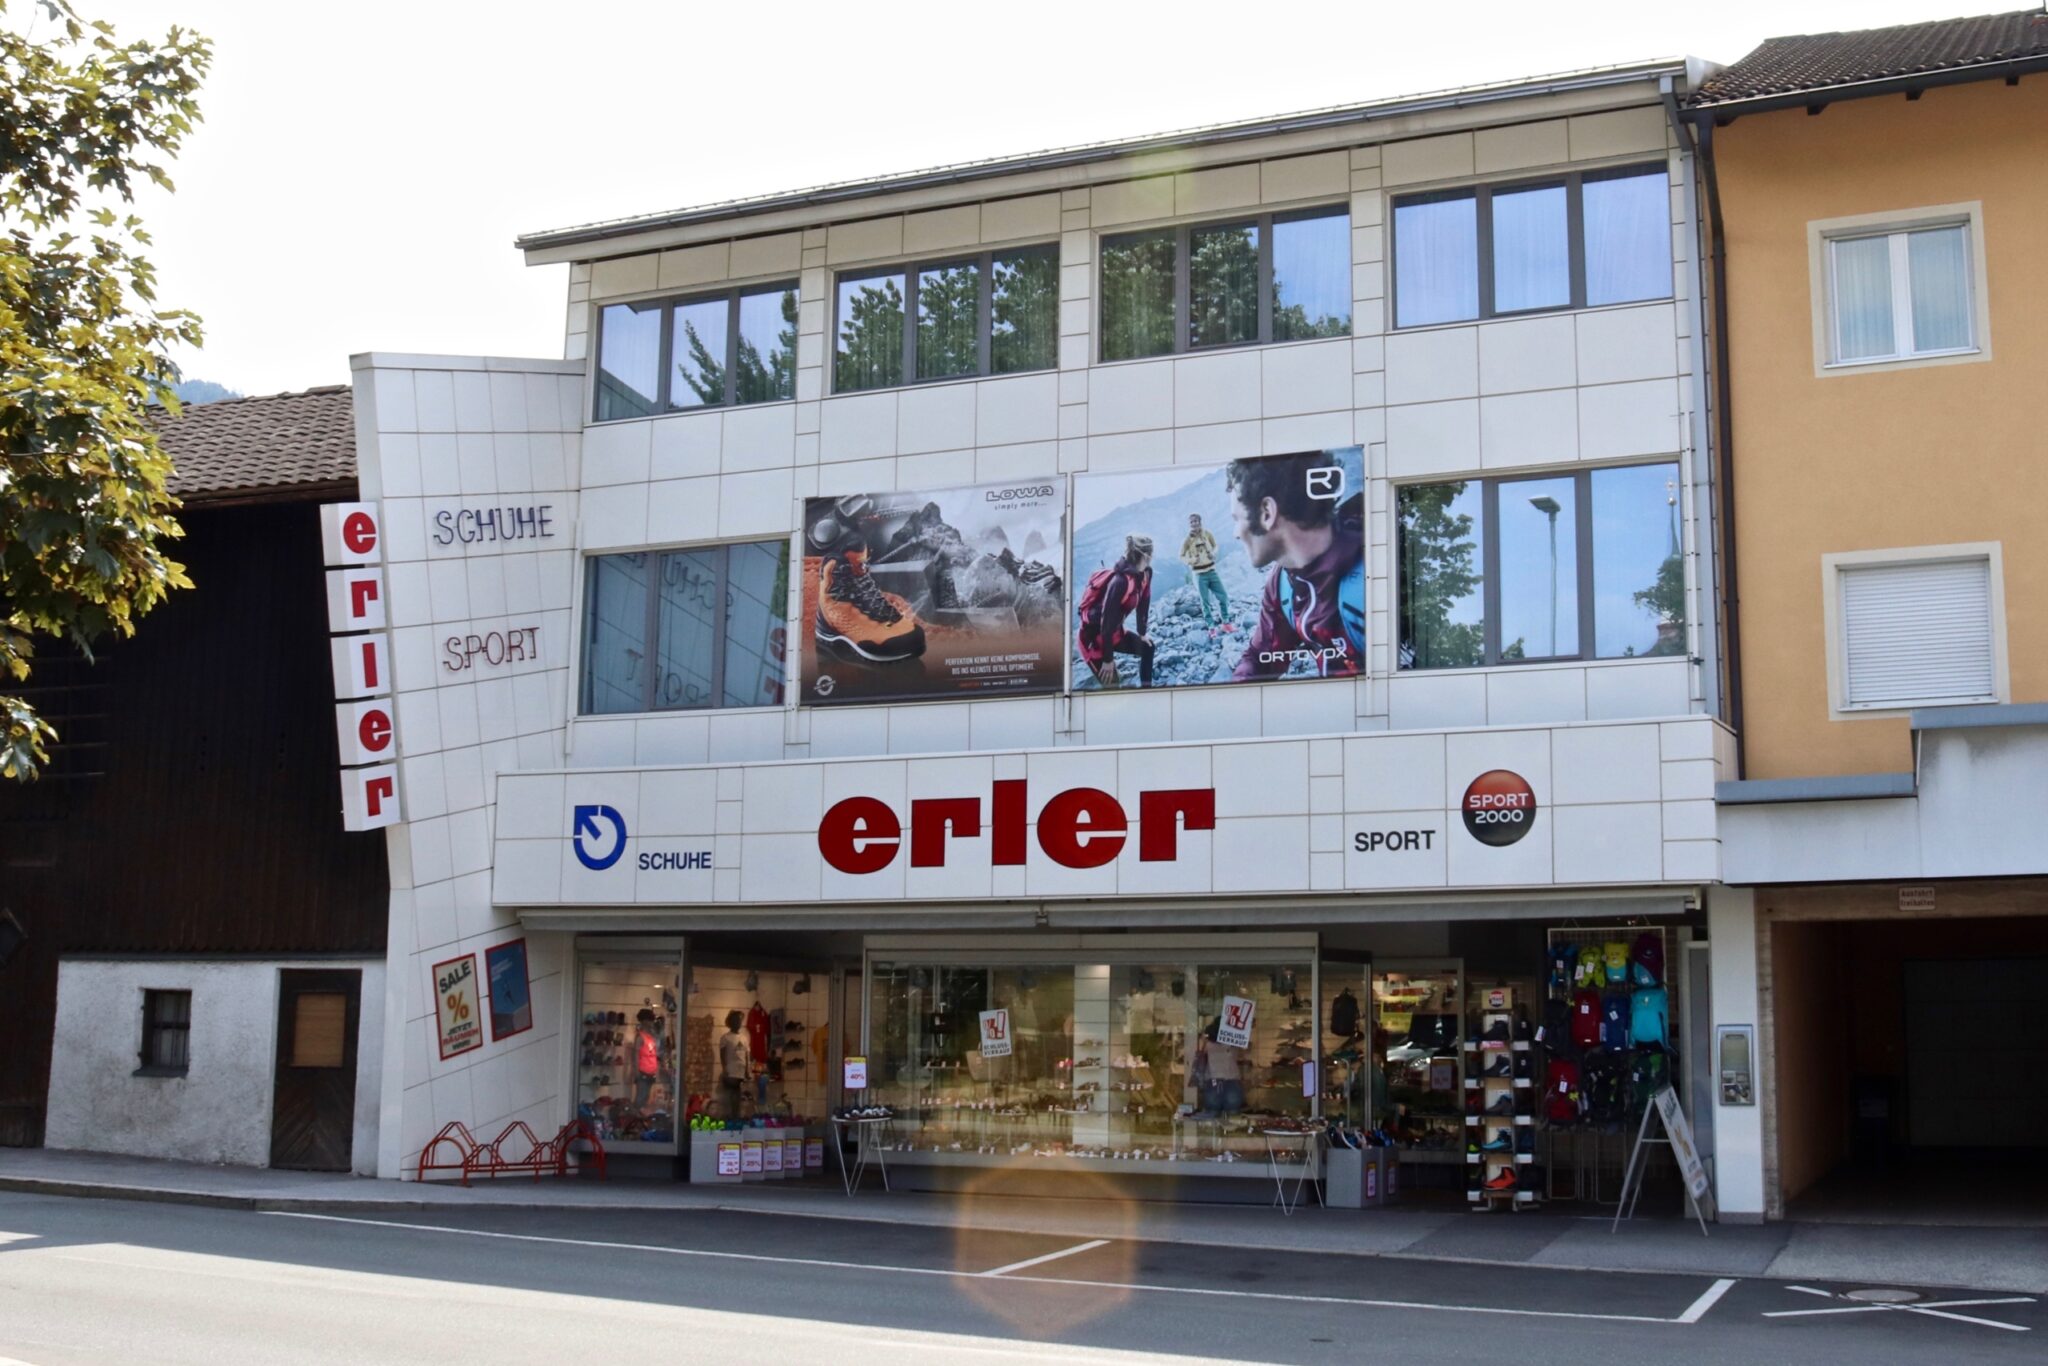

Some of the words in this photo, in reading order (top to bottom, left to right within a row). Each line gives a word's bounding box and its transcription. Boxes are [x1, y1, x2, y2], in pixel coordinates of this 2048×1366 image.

[986, 485, 1054, 502] LOWA
[994, 503, 1018, 511] simply
[433, 505, 555, 545] SCHUHE
[442, 627, 540, 672] SPORT
[1259, 648, 1348, 664] ORTOVOX
[1469, 792, 1530, 809] SPORT
[818, 779, 1215, 874] erler
[1475, 809, 1525, 824] 2000
[1354, 830, 1436, 852] SPORT
[638, 851, 713, 871] SCHUHE
[439, 961, 471, 994] SALE
